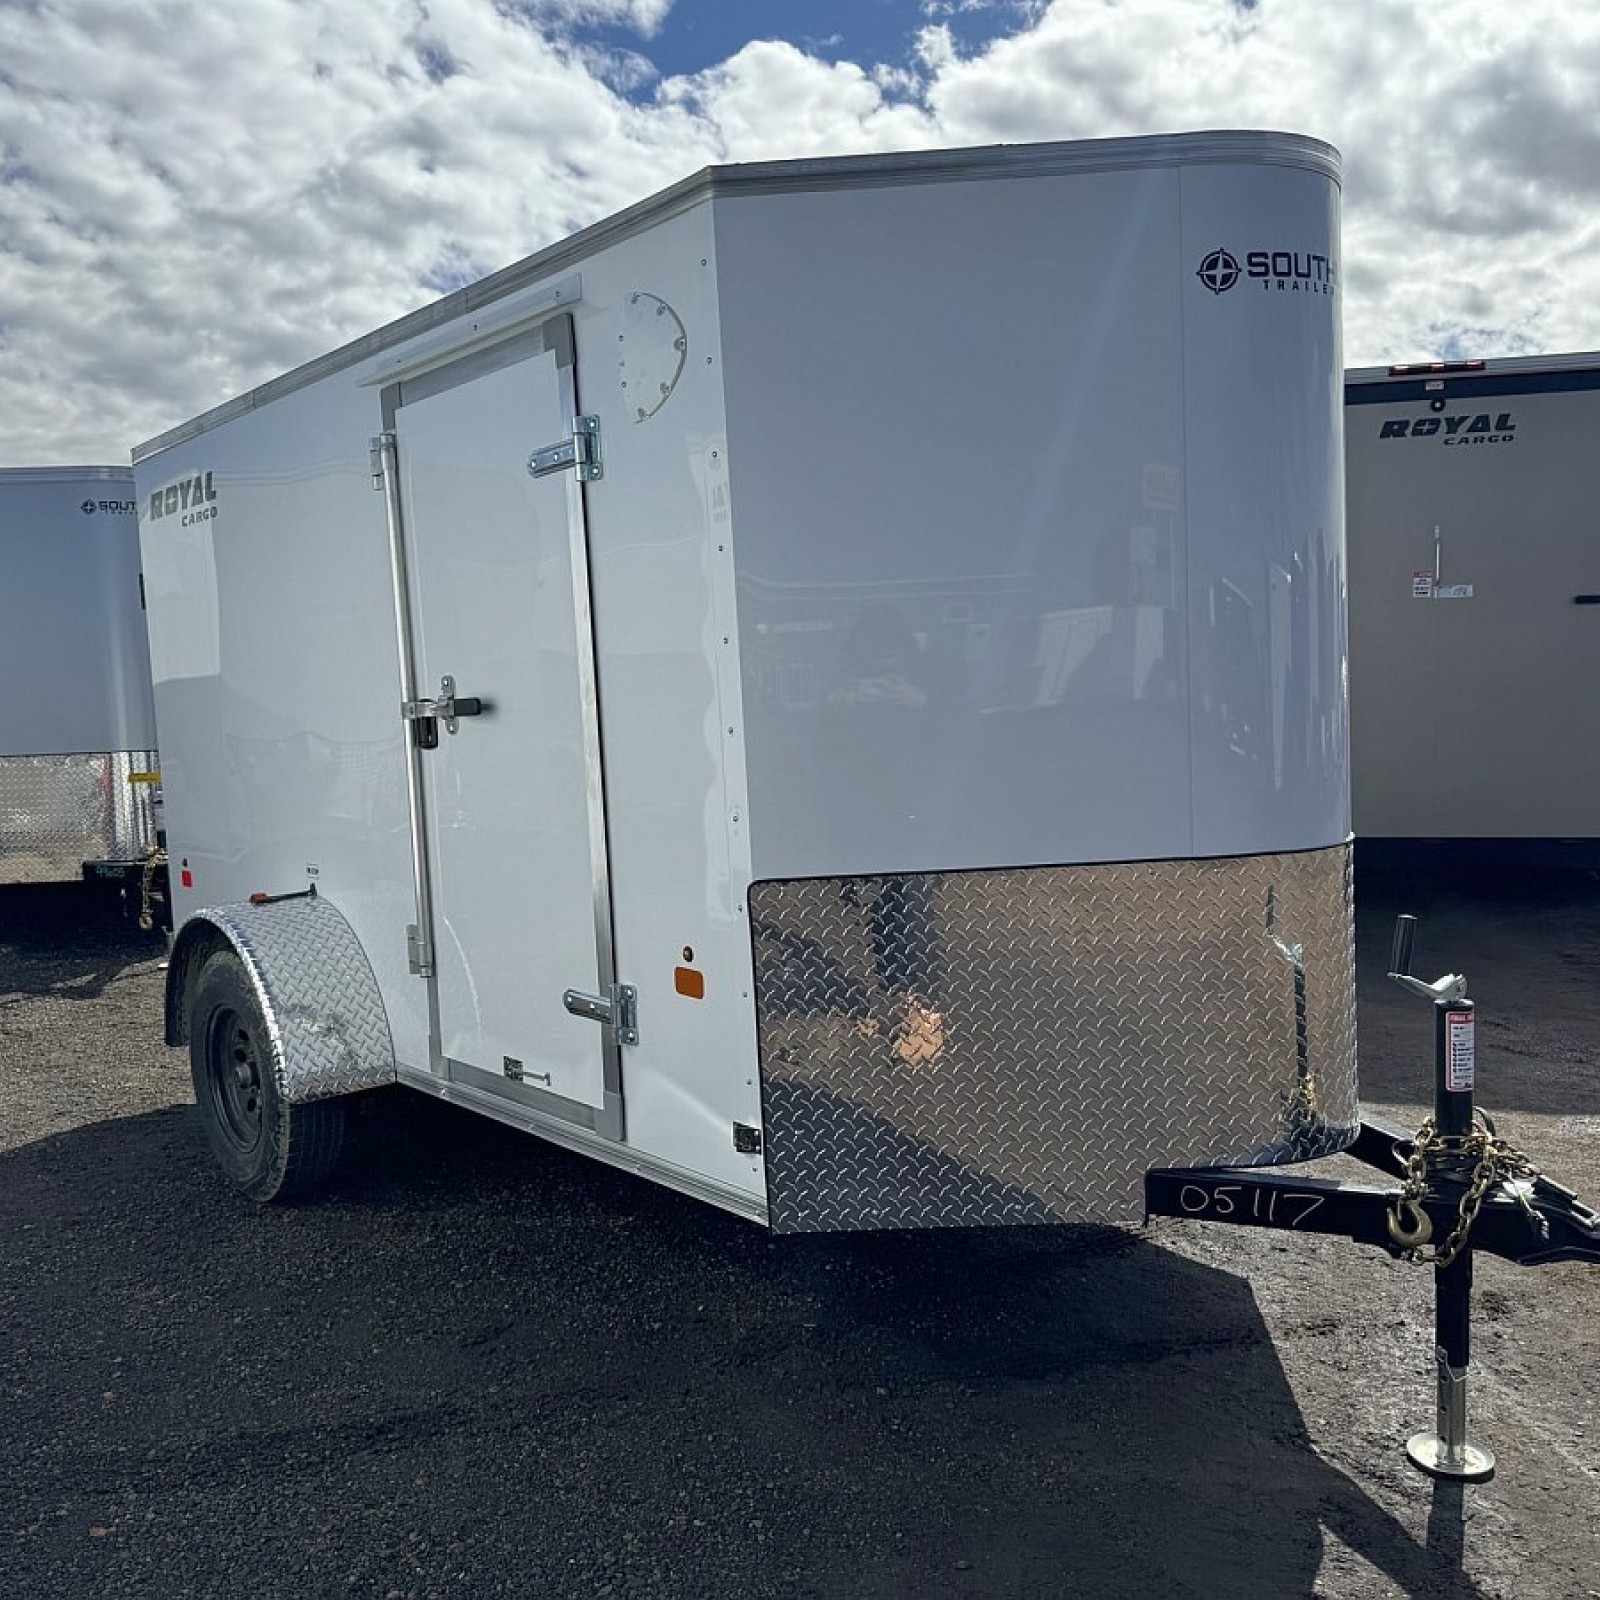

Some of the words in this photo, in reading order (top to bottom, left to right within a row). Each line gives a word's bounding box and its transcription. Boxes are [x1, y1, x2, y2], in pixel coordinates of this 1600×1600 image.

[1379, 413, 1516, 439] ROYAL
[1443, 434, 1514, 445] CARGO
[150, 470, 218, 522] ROYAL
[181, 506, 218, 527] CARGO
[1180, 1185, 1326, 1227] 05117
